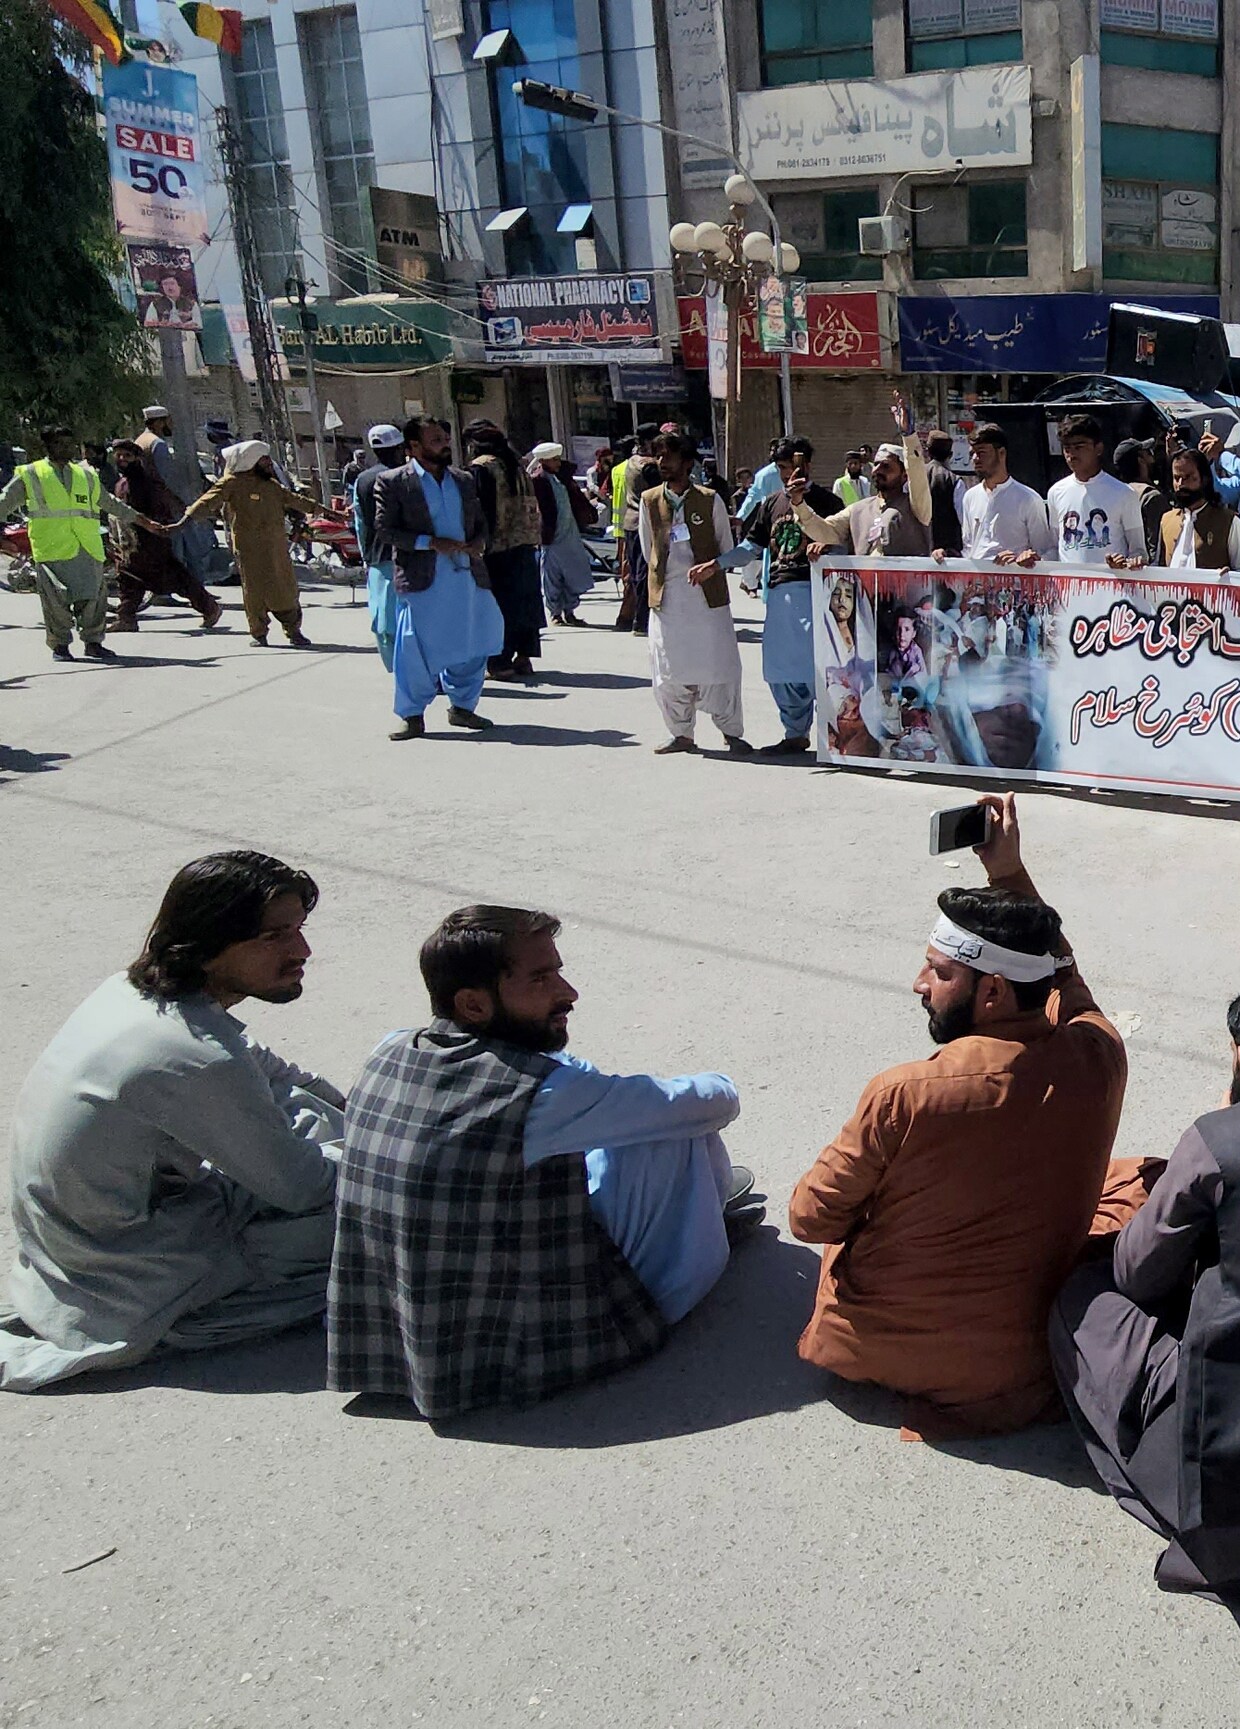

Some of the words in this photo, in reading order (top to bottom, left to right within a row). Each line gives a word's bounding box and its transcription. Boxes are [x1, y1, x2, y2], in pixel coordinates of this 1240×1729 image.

[108, 96, 195, 127] SUMMER
[921, 79, 1017, 158] شاہ
[119, 127, 192, 159] SALE
[380, 228, 420, 246] ATM
[496, 282, 556, 308] NATIONAL
[556, 278, 625, 306] PHARMACY
[280, 327, 304, 345] Ban
[316, 323, 340, 345] AL
[341, 322, 388, 346] Habib
[391, 322, 423, 345] Ltd.
[524, 308, 595, 345] فارمیسی
[595, 307, 653, 345] نیشنل
[985, 312, 1024, 349] طیب
[1071, 602, 1146, 657] مظاہرہ
[1144, 603, 1221, 665] احتجاجی
[1071, 686, 1136, 746] سلام
